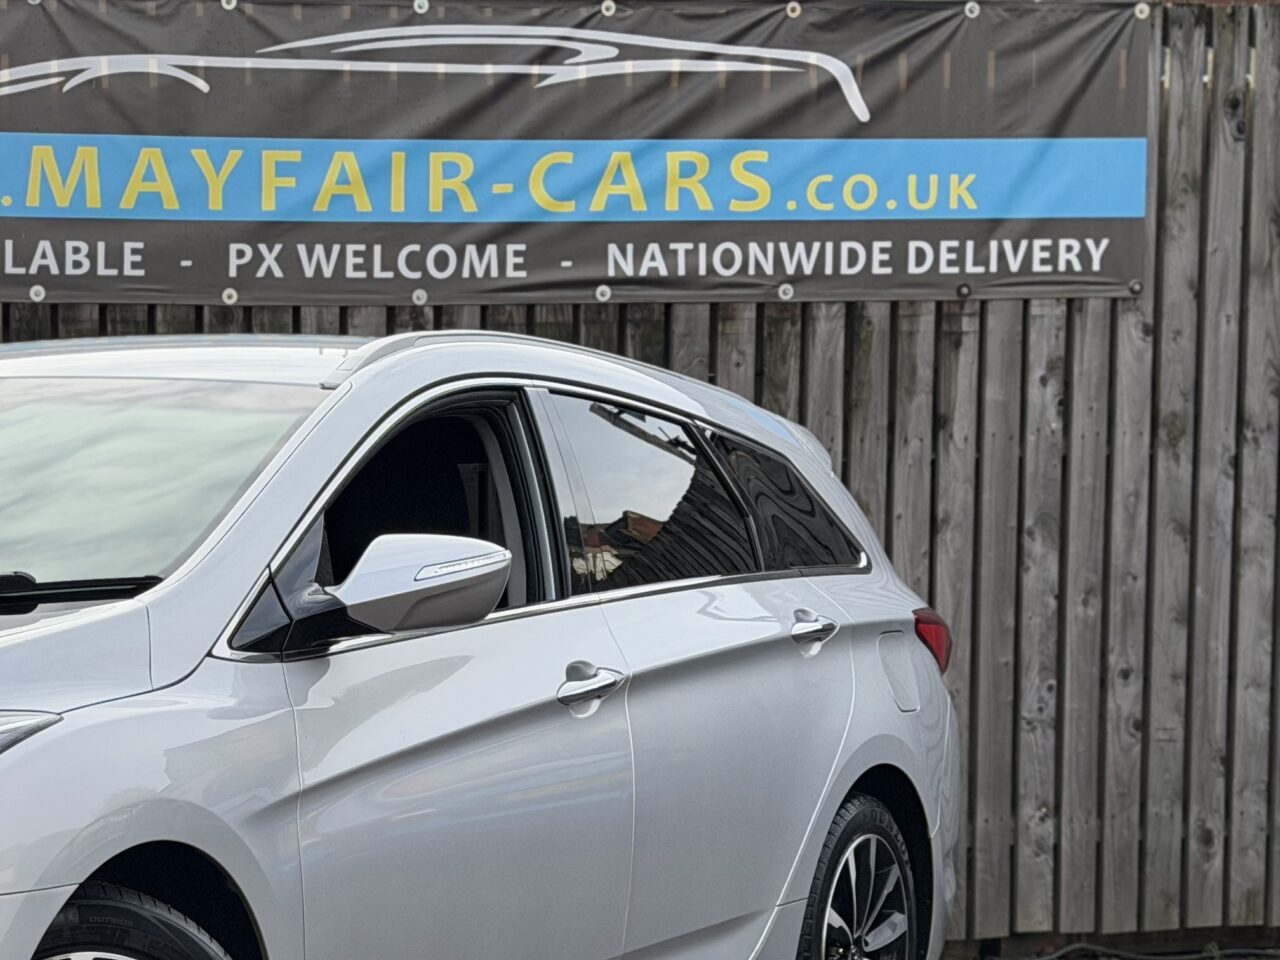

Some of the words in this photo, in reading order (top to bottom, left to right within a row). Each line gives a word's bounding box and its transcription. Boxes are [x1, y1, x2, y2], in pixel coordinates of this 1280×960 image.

[228, 243, 284, 278] PX
[296, 243, 528, 280] WELCOME
[607, 240, 893, 277] NATIONWIDE
[907, 237, 1110, 275] DELIVERY
